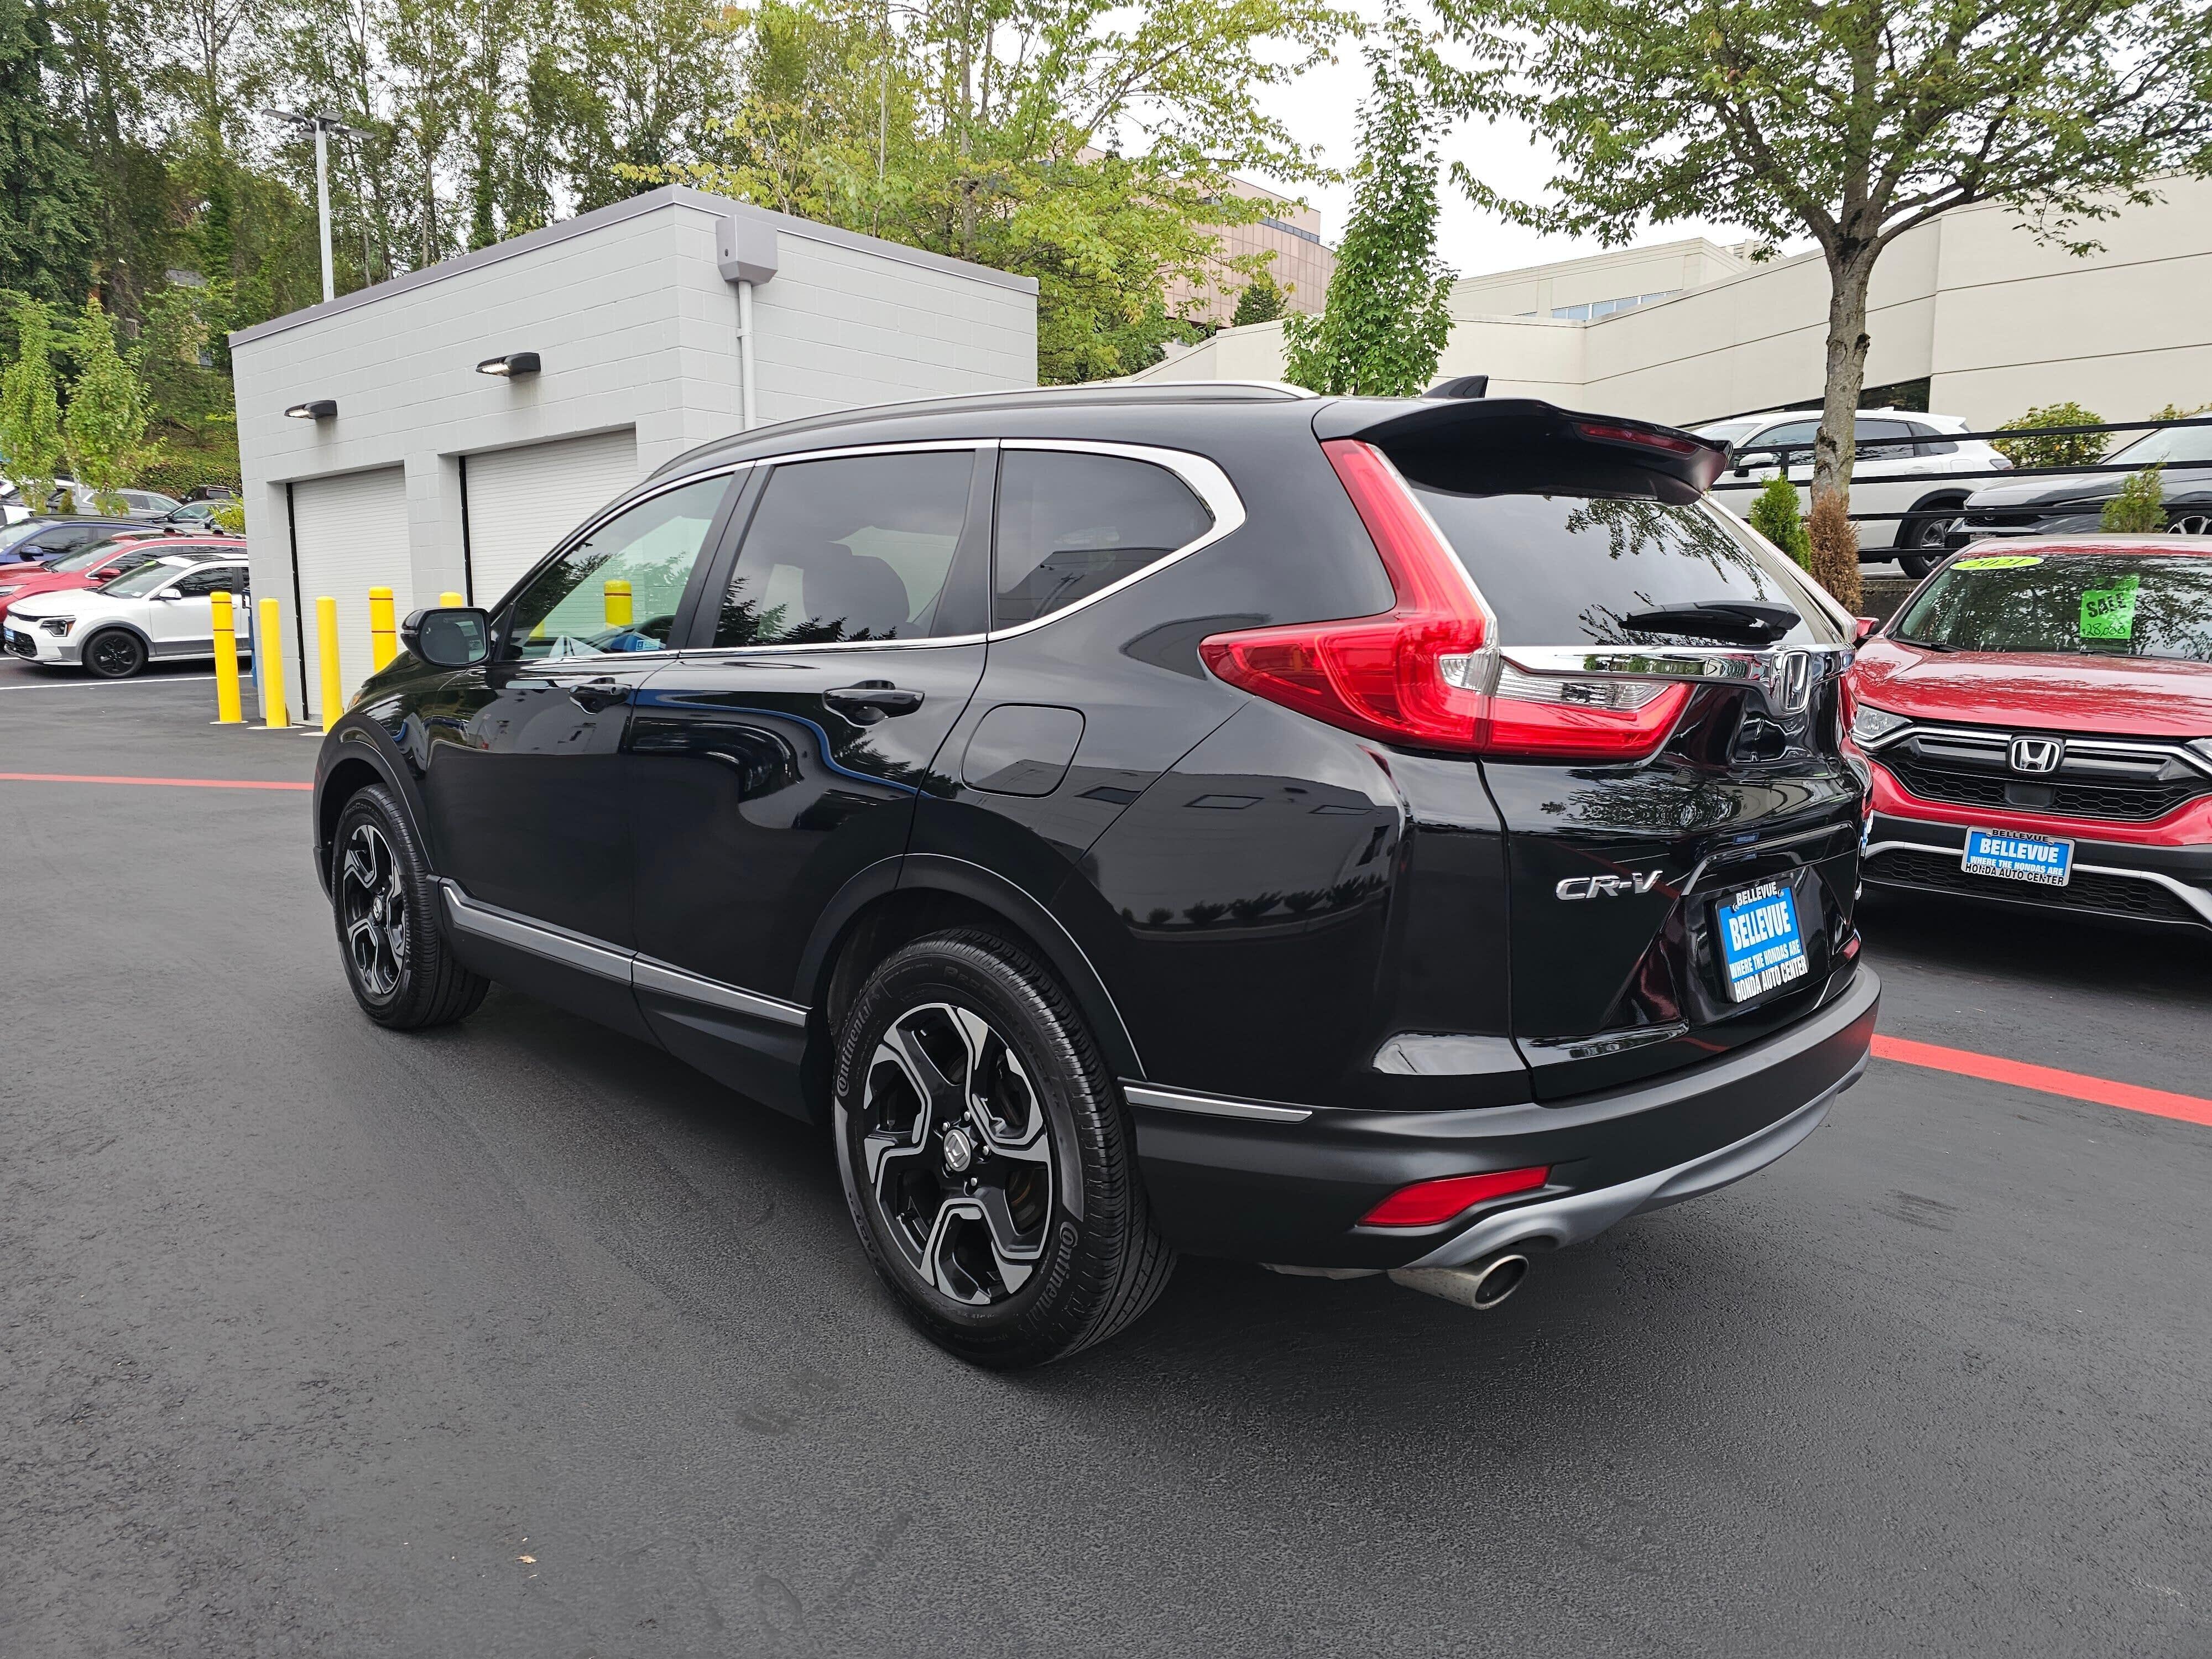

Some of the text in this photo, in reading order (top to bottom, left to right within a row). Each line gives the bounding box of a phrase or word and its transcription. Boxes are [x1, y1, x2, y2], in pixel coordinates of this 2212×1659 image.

[1964, 558, 2027, 568] 2021
[2086, 592, 2127, 618] SALE
[1991, 829, 2049, 843] BELLEVUE
[1979, 838, 2059, 863] BELLEVUE
[1965, 863, 2064, 885] HONDA AUTO CENTER
[1970, 855, 2064, 876] WHERE THE HONDAS ARE
[1556, 870, 1663, 900] CR-V
[1736, 881, 1777, 906] BELLEVUE
[1729, 901, 1792, 952] BELLEVUE
[1729, 939, 1801, 979] WHERE THE HONDAS ARE
[1734, 954, 1809, 1003] HONDA AUTO CENTER
[837, 997, 872, 1097] Continental
